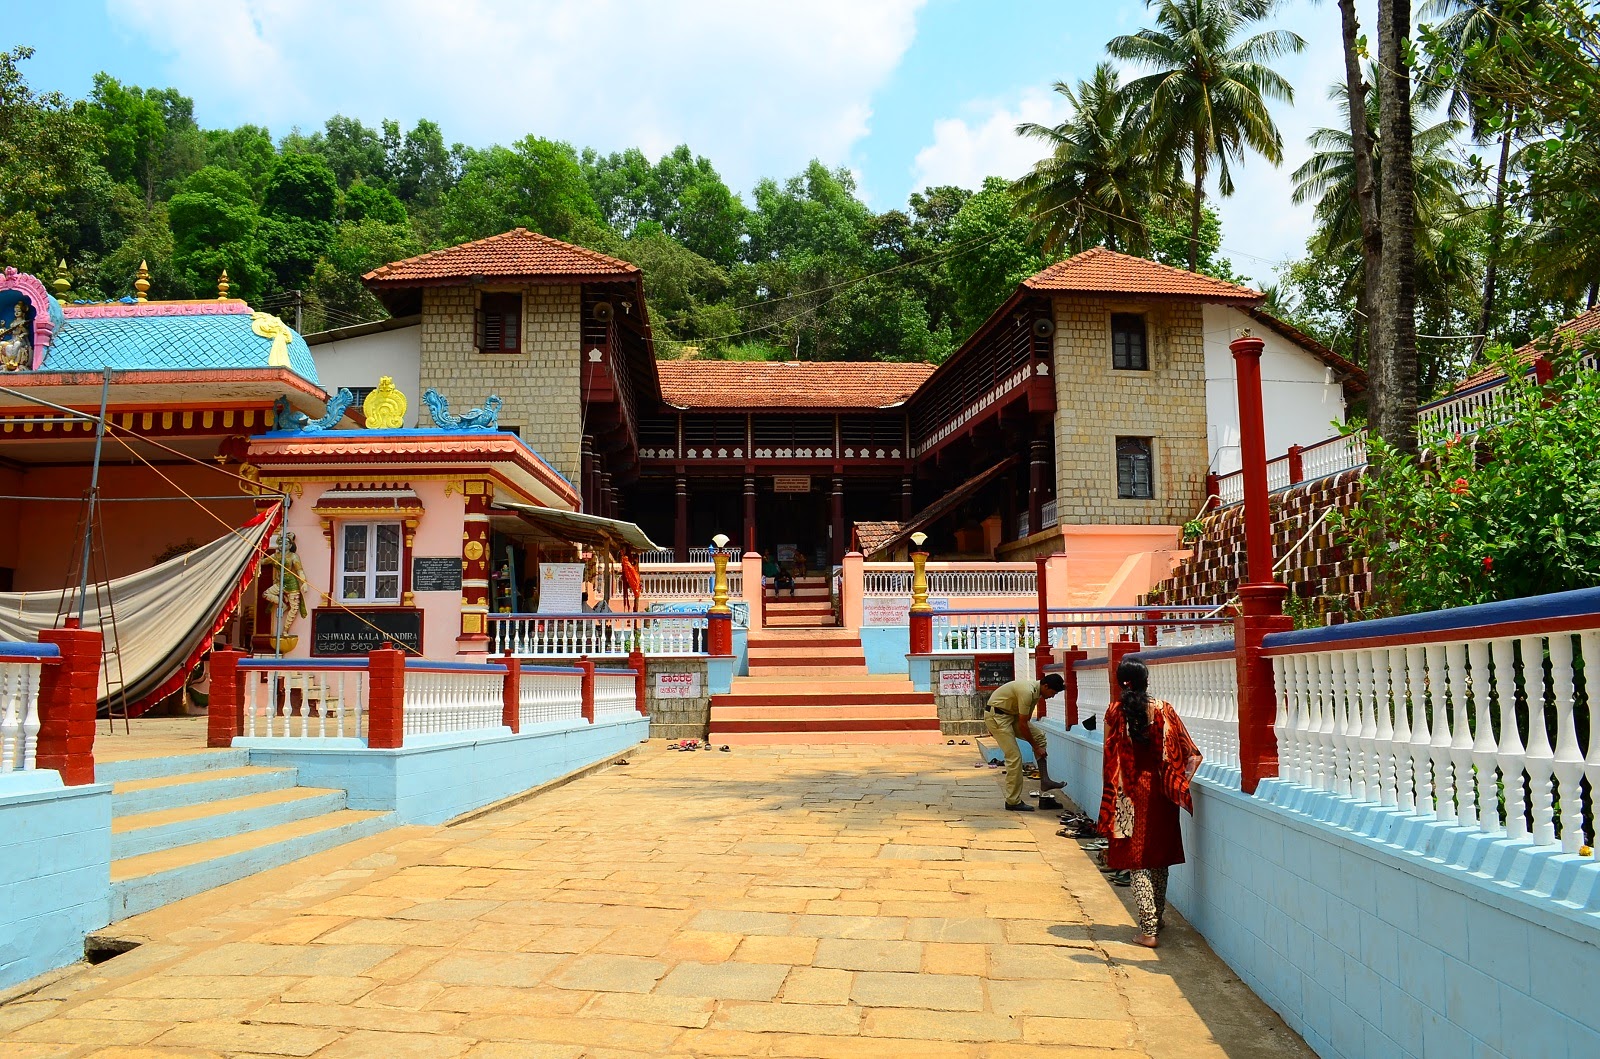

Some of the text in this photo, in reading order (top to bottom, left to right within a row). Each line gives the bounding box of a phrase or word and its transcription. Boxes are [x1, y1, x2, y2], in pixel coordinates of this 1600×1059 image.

[317, 632, 418, 641] ESHWARA KALA MANDIRA
[350, 641, 374, 651] ಕಲಾ
